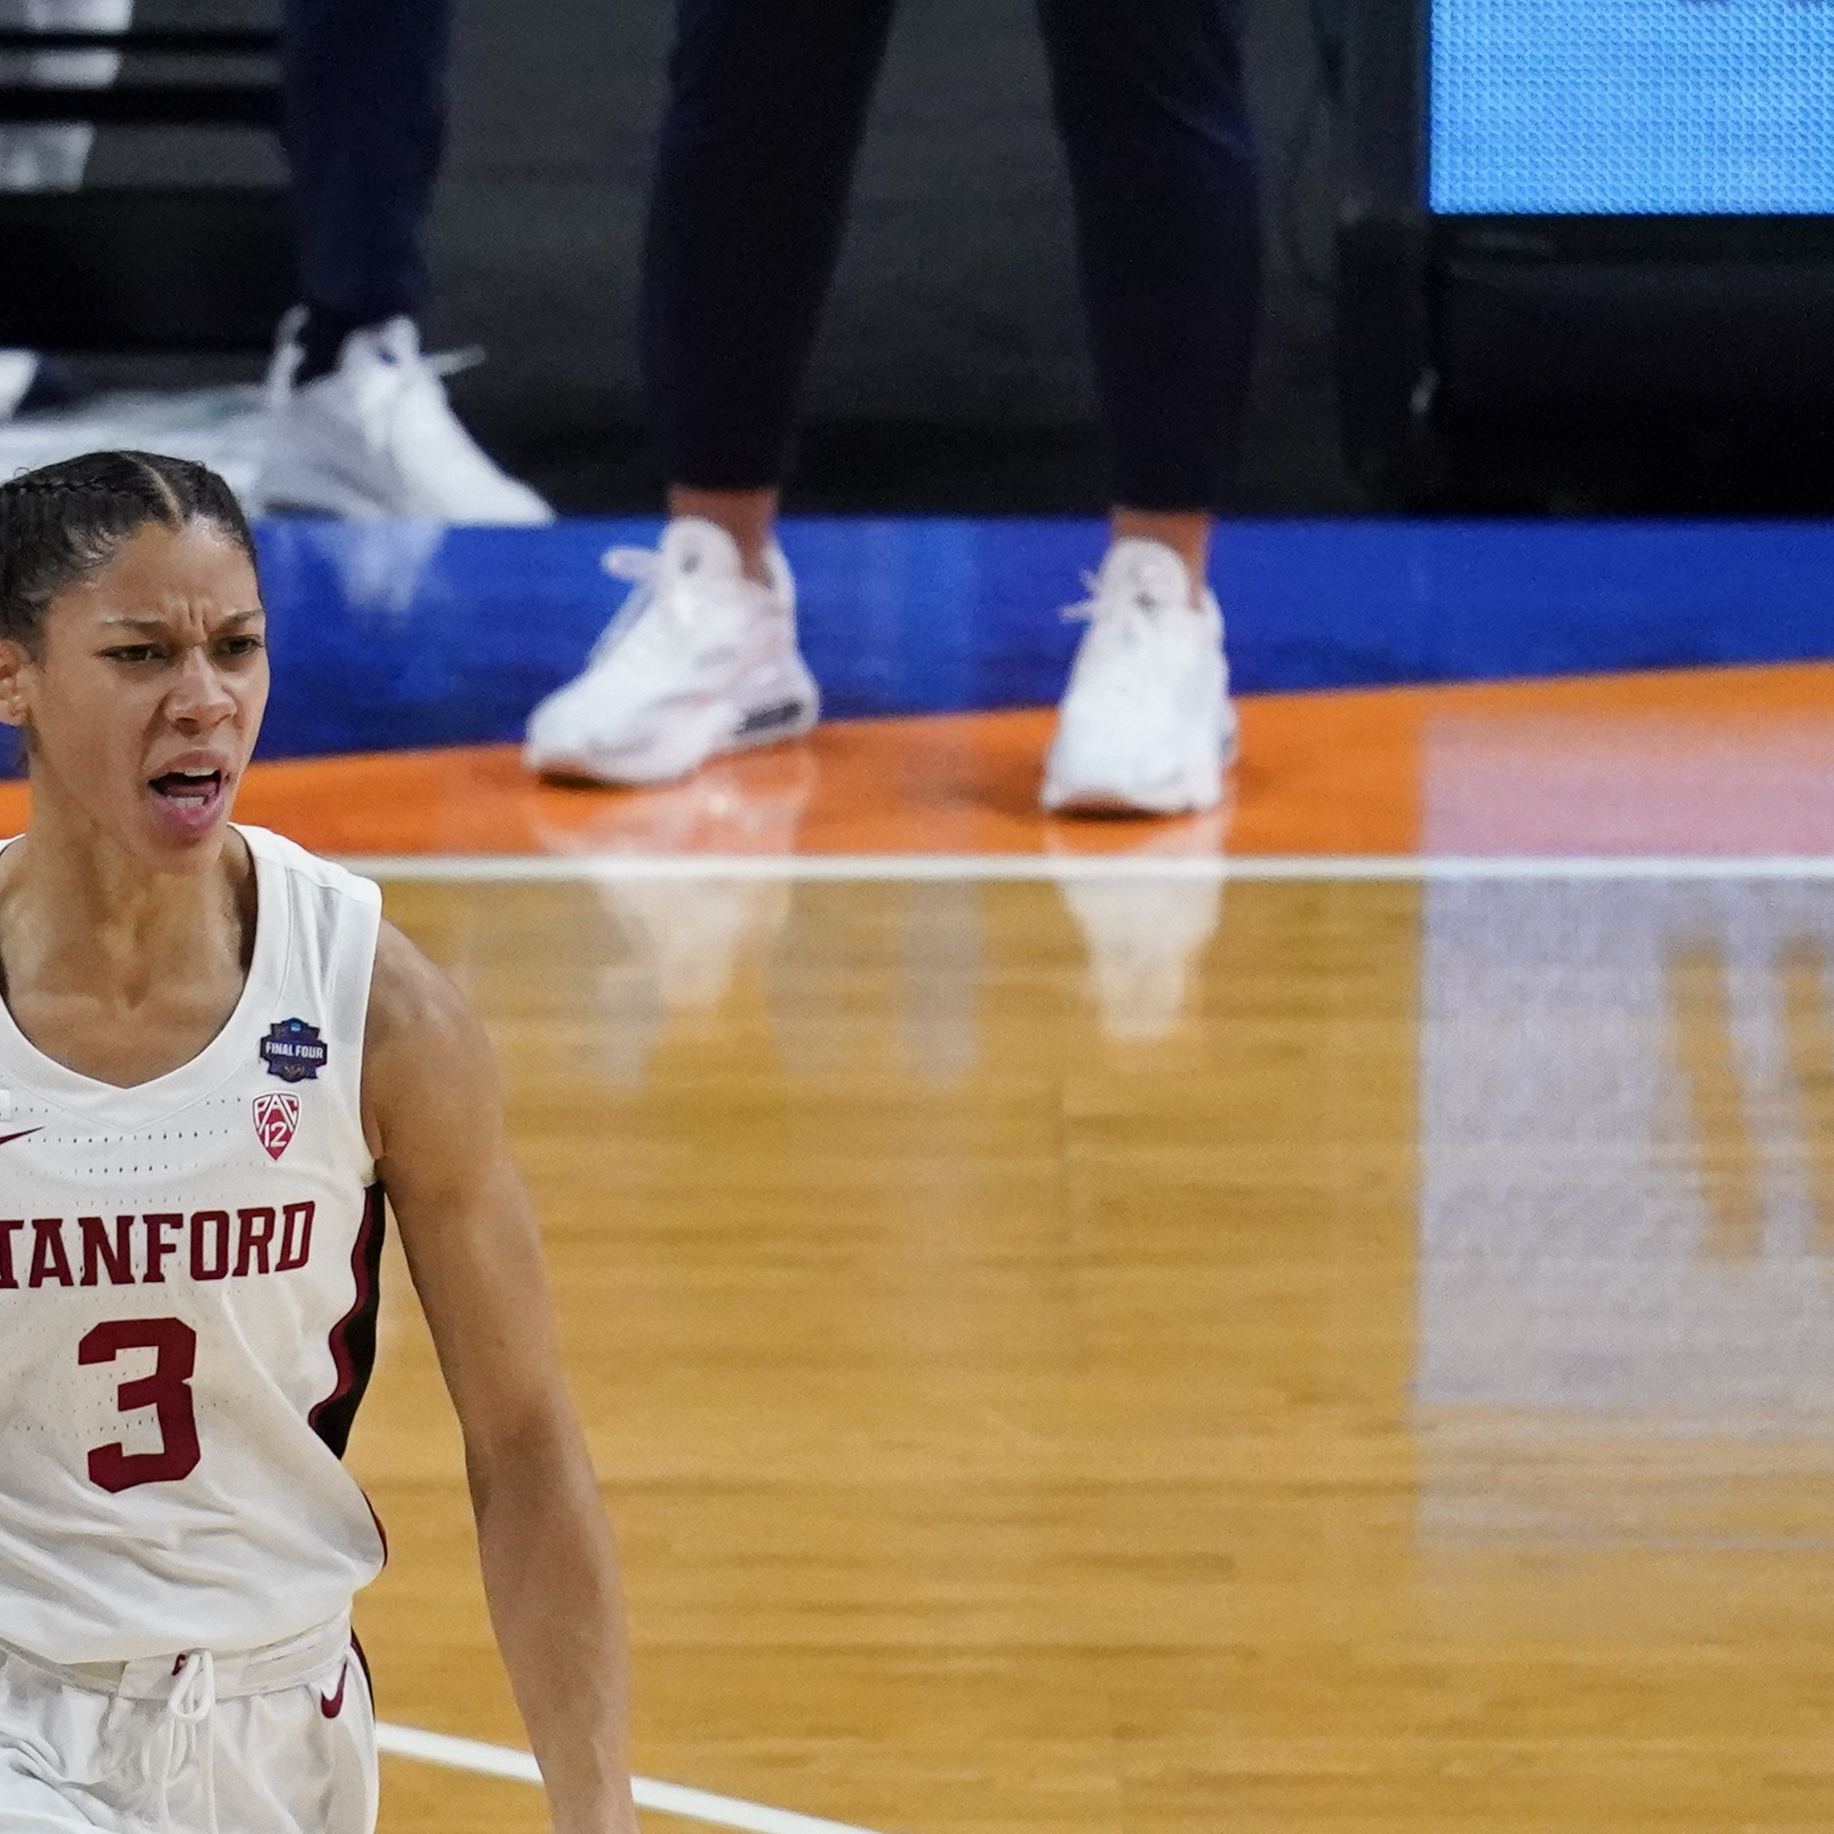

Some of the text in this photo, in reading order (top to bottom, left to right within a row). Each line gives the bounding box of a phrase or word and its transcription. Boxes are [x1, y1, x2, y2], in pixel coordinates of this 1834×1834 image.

[265, 1041, 324, 1060] FINAL FOUR
[253, 1094, 299, 1135] PAC
[264, 1121, 288, 1148] 12
[78, 1316, 201, 1494] 3
